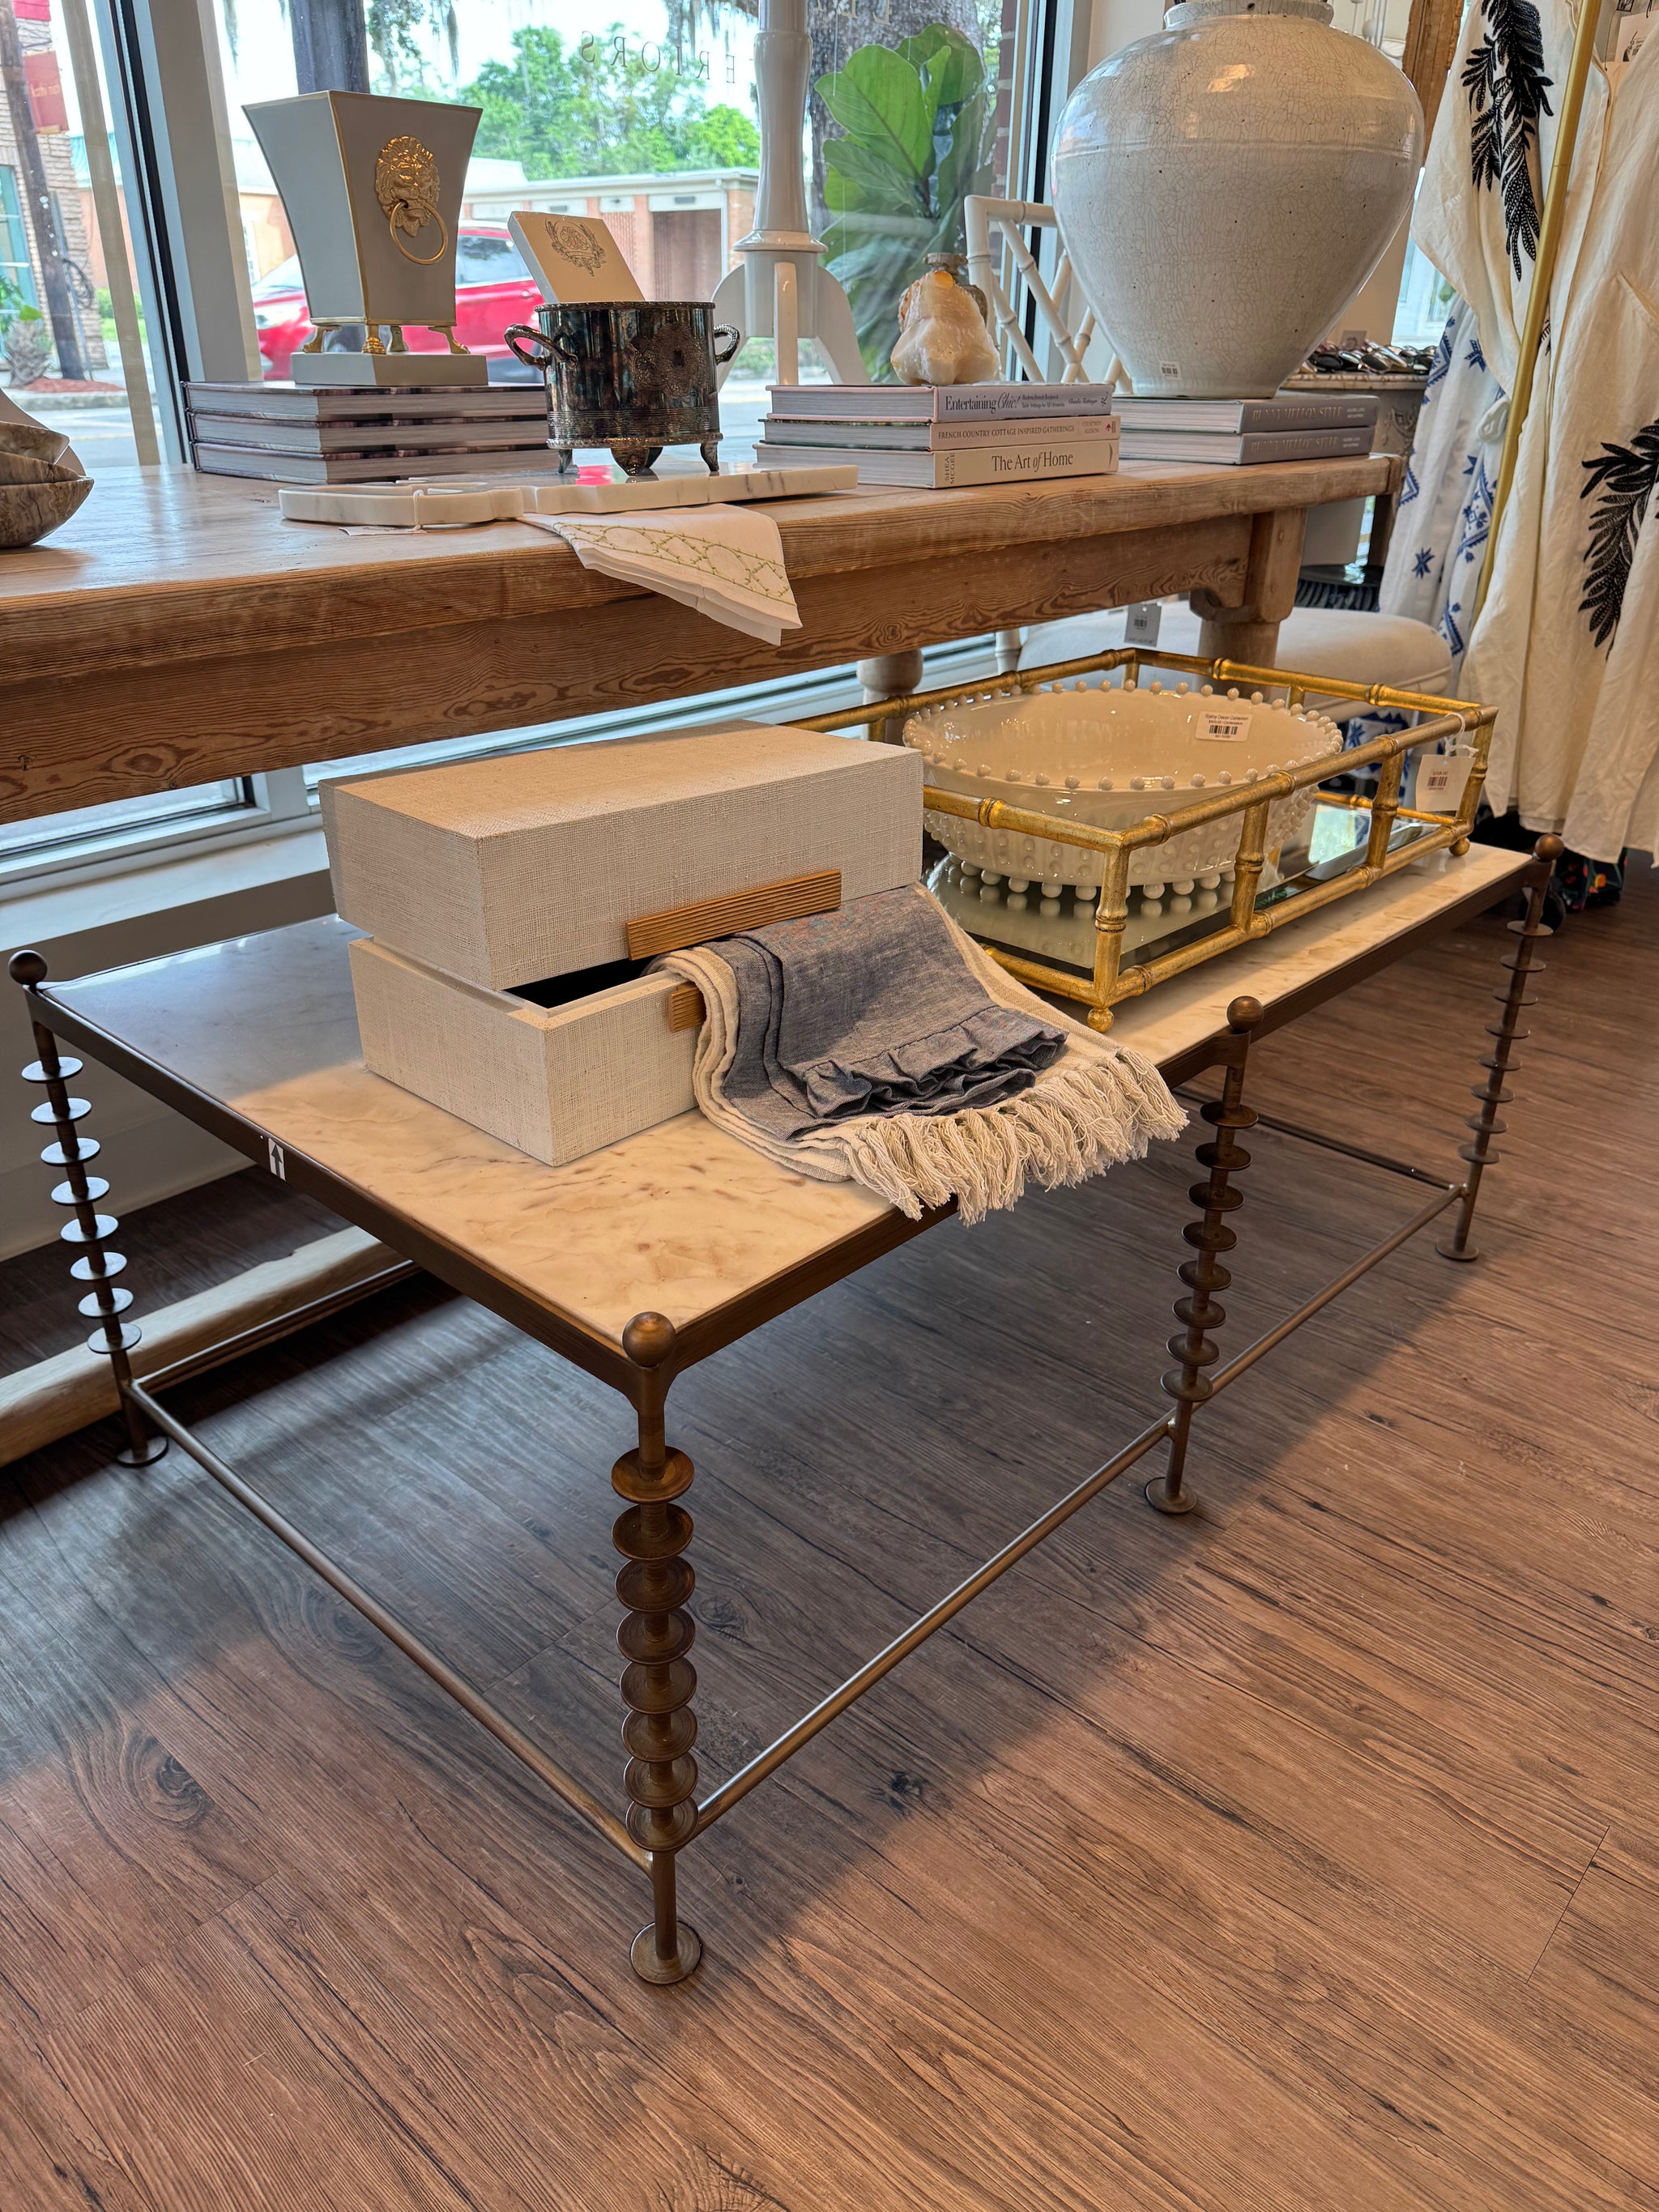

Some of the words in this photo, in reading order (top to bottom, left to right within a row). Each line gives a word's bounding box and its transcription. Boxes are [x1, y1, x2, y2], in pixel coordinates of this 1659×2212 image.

[945, 395, 997, 415] Entertaining
[997, 392, 1021, 409] Chic!
[938, 431, 962, 439] FRENCH
[962, 429, 990, 438] COUNTRY
[991, 428, 1016, 437] COTTAGE
[1017, 426, 1042, 435] INSPIRED
[1043, 425, 1075, 434] GATHERINGS
[992, 455, 1013, 471] The
[1014, 454, 1030, 470] Art
[1033, 452, 1043, 473] of
[1043, 451, 1074, 467] Home
